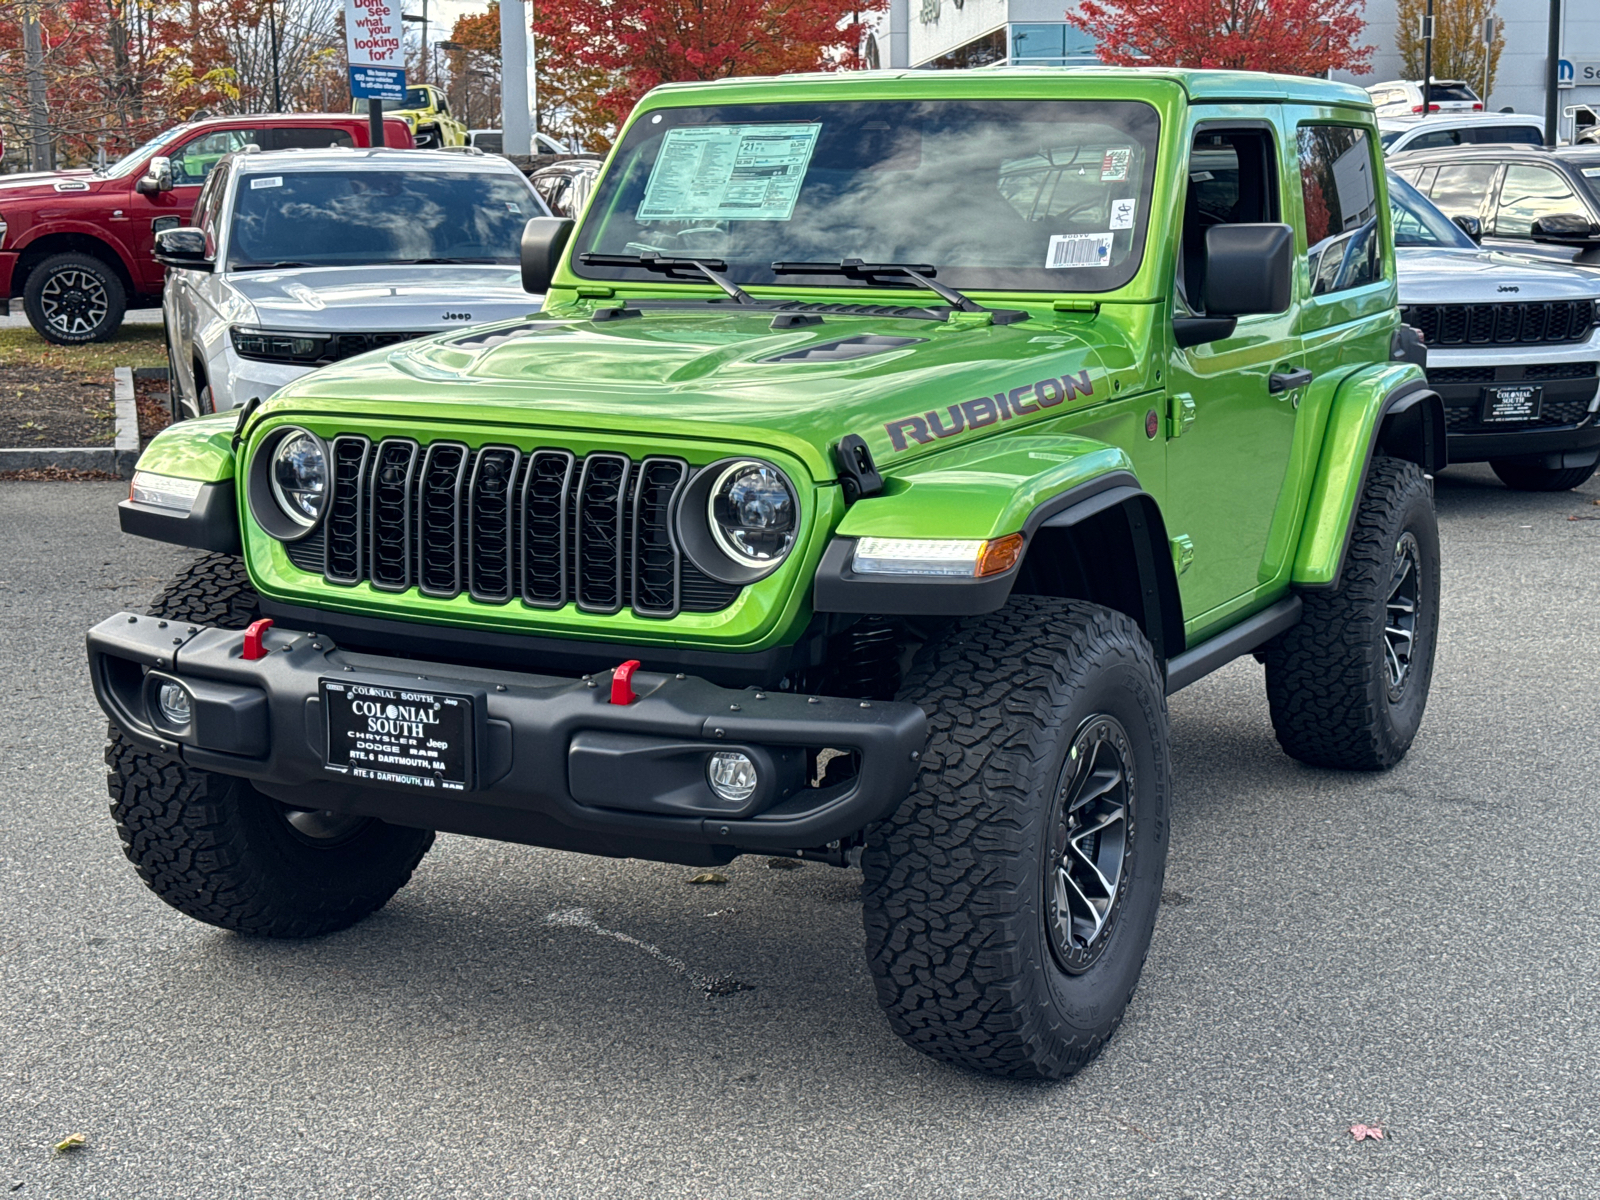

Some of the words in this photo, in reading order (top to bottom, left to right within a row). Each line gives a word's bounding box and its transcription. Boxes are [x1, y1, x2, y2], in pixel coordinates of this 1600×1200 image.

[368, 7, 391, 17] see
[355, 16, 384, 28] what
[368, 26, 392, 38] your
[354, 36, 400, 50] looking
[369, 47, 394, 62] for?
[743, 142, 755, 151] 21
[1496, 285, 1520, 293] Jeep
[442, 311, 472, 321] Jeep
[883, 369, 1094, 453] RUBICON
[352, 686, 397, 699] COLONIAL
[400, 692, 435, 703] SOUTH
[352, 700, 440, 725] COLONIAL
[367, 717, 425, 738] SOUTH
[347, 730, 418, 746] CHRYSLER
[426, 738, 449, 751] Jeep
[356, 740, 401, 754] DODGE
[409, 748, 439, 758] RAM
[349, 750, 368, 760] RTE.
[368, 752, 375, 761] 6
[377, 754, 431, 769] DARTMOUTH,
[432, 760, 446, 770] MA
[353, 768, 369, 778] RTE.
[369, 771, 375, 779] 6
[376, 772, 423, 787] DARTMOUTH,
[423, 778, 436, 787] MA
